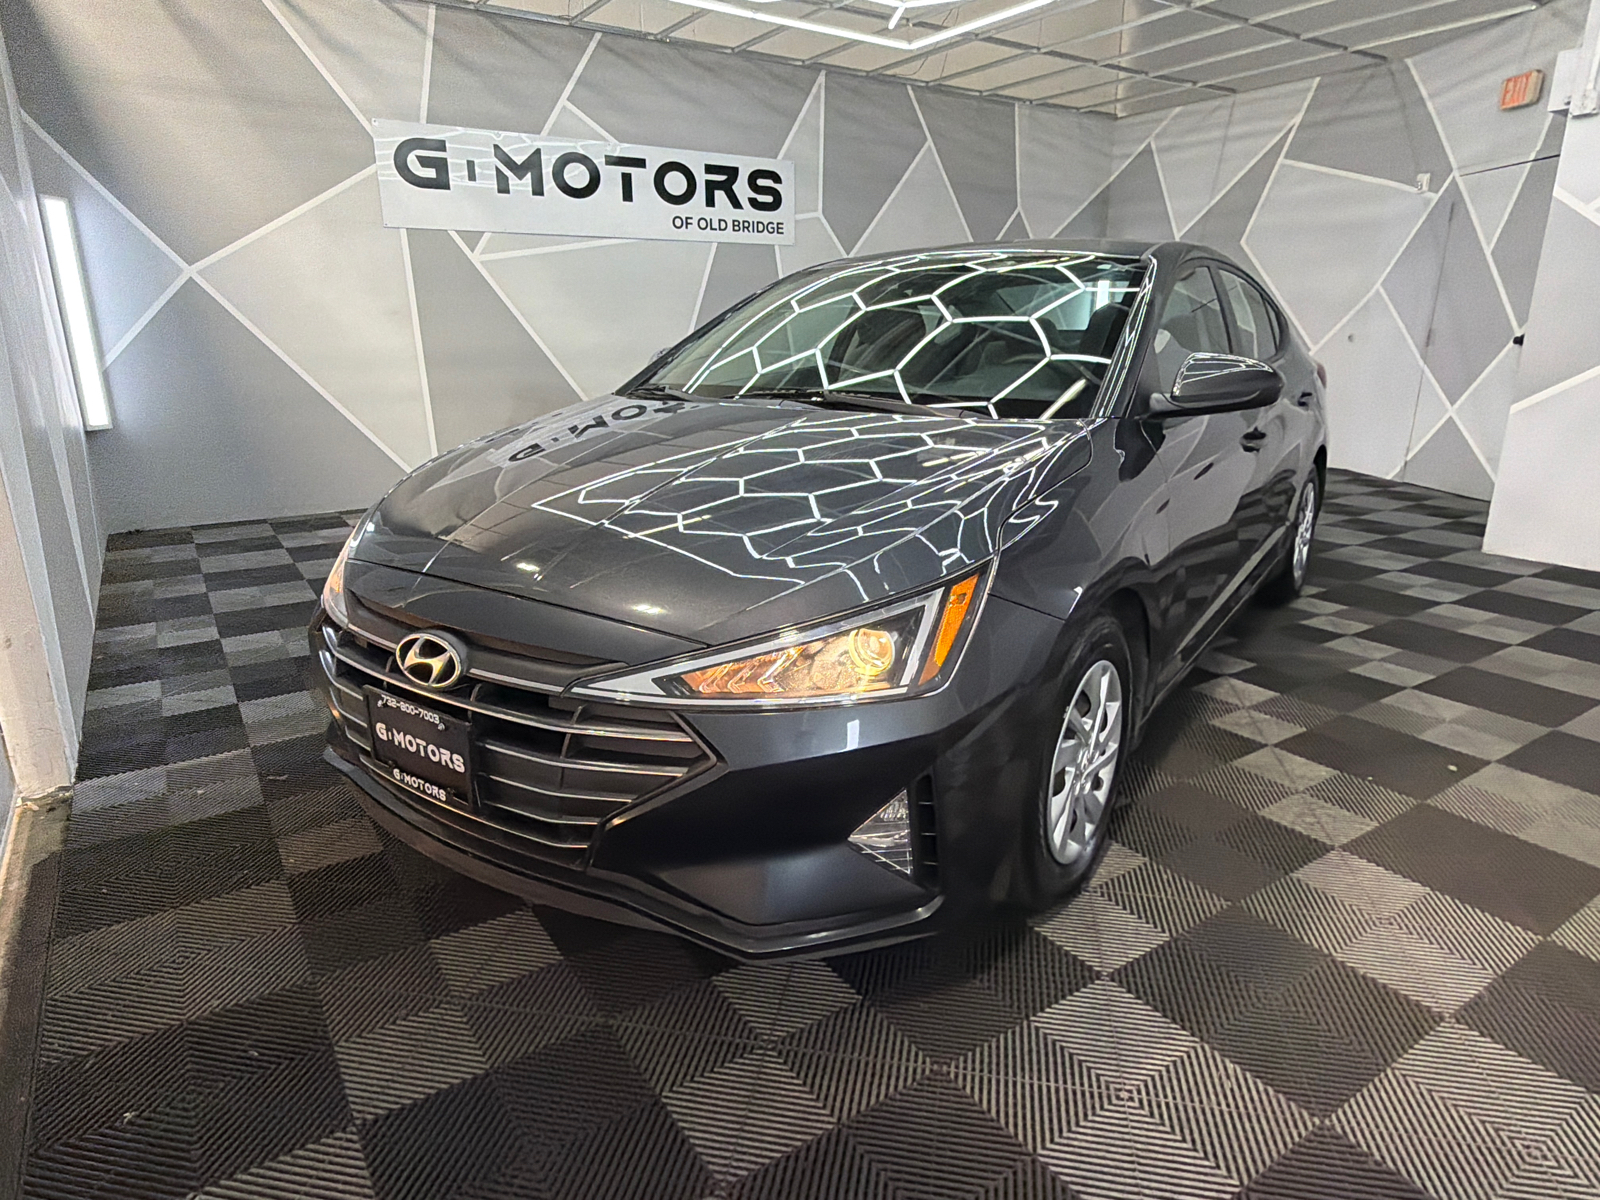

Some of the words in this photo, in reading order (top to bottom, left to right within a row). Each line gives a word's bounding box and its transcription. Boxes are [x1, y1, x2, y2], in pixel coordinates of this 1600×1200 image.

[672, 215, 693, 229] OF
[697, 217, 728, 231] OLD
[732, 219, 784, 235] BRIDGE
[381, 694, 440, 724] 732-800-7003
